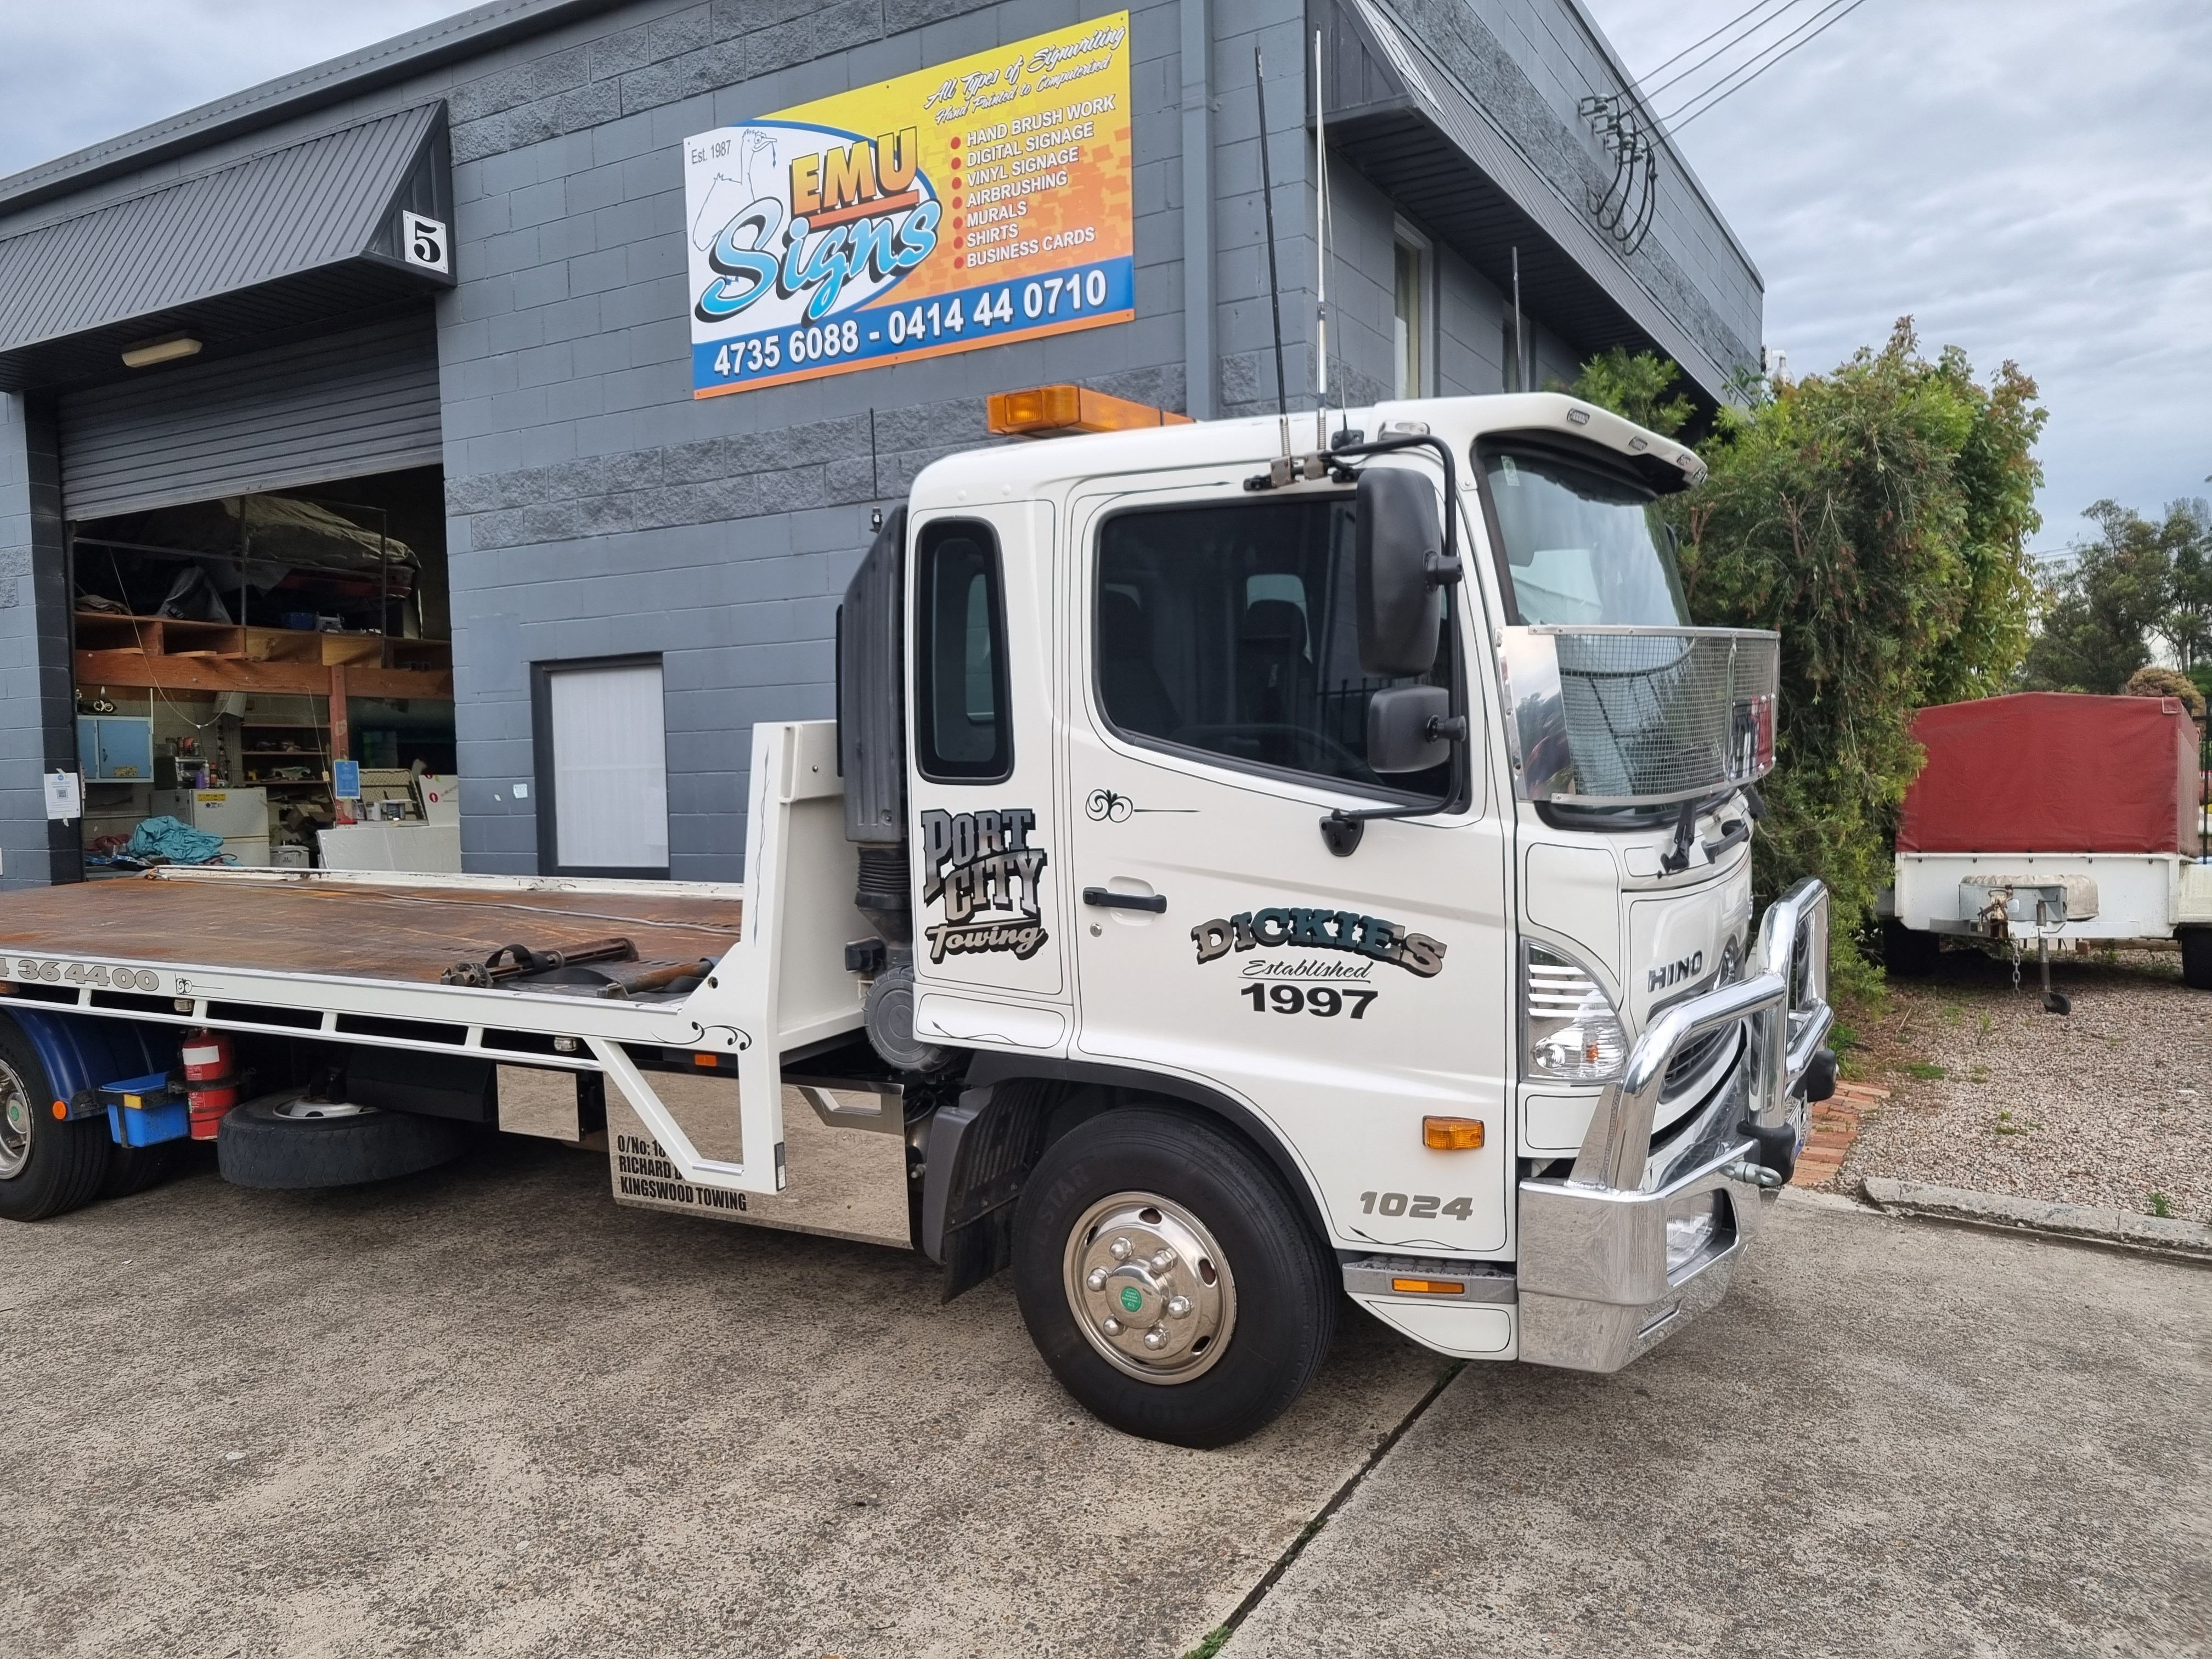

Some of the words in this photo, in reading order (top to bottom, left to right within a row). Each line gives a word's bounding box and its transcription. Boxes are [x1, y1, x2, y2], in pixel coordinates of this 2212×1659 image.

[924, 77, 957, 109] All
[961, 69, 1000, 100] Types
[1005, 55, 1024, 86] of
[1027, 26, 1126, 72] Signwriting
[935, 99, 970, 125] Hand
[973, 86, 1017, 112] Painted
[1020, 83, 1031, 97] to
[967, 123, 1007, 147] HAND
[1012, 109, 1063, 136] BRUSH
[1066, 94, 1115, 121] WORK
[691, 147, 708, 165] Est.
[710, 139, 731, 160] 1987
[967, 141, 1022, 167] DIGITAL
[1026, 121, 1094, 152] SIGNAGE
[790, 126, 918, 216] EMU
[967, 165, 1008, 187] VINYL
[1012, 146, 1079, 176] SIGNAGE
[967, 170, 1068, 208] AIRBRUSHING
[967, 200, 1028, 228] MURALS
[414, 220, 441, 263] 5
[967, 239, 1039, 268] BUSINESS
[1042, 226, 1096, 251] CARDS
[968, 223, 1019, 248] SHIRTS
[697, 197, 942, 323] Signs
[714, 336, 781, 376] 4735
[789, 320, 859, 363] 6088
[889, 298, 964, 345] 0414
[973, 288, 1013, 326] 44
[1024, 270, 1107, 318] 0710
[921, 808, 1036, 908] PORT
[943, 848, 1047, 924] CITY
[926, 919, 1048, 964] Towing
[1190, 907, 1447, 978] DICKIES
[1242, 959, 1374, 978] Established
[1648, 950, 1702, 992] HINO
[1240, 983, 1379, 1019] 1997
[619, 1155, 672, 1179] RICHARD
[620, 1176, 694, 1203] KINGSWOOD
[696, 1187, 747, 1211] TOWING
[1359, 1190, 1474, 1221] 1024
